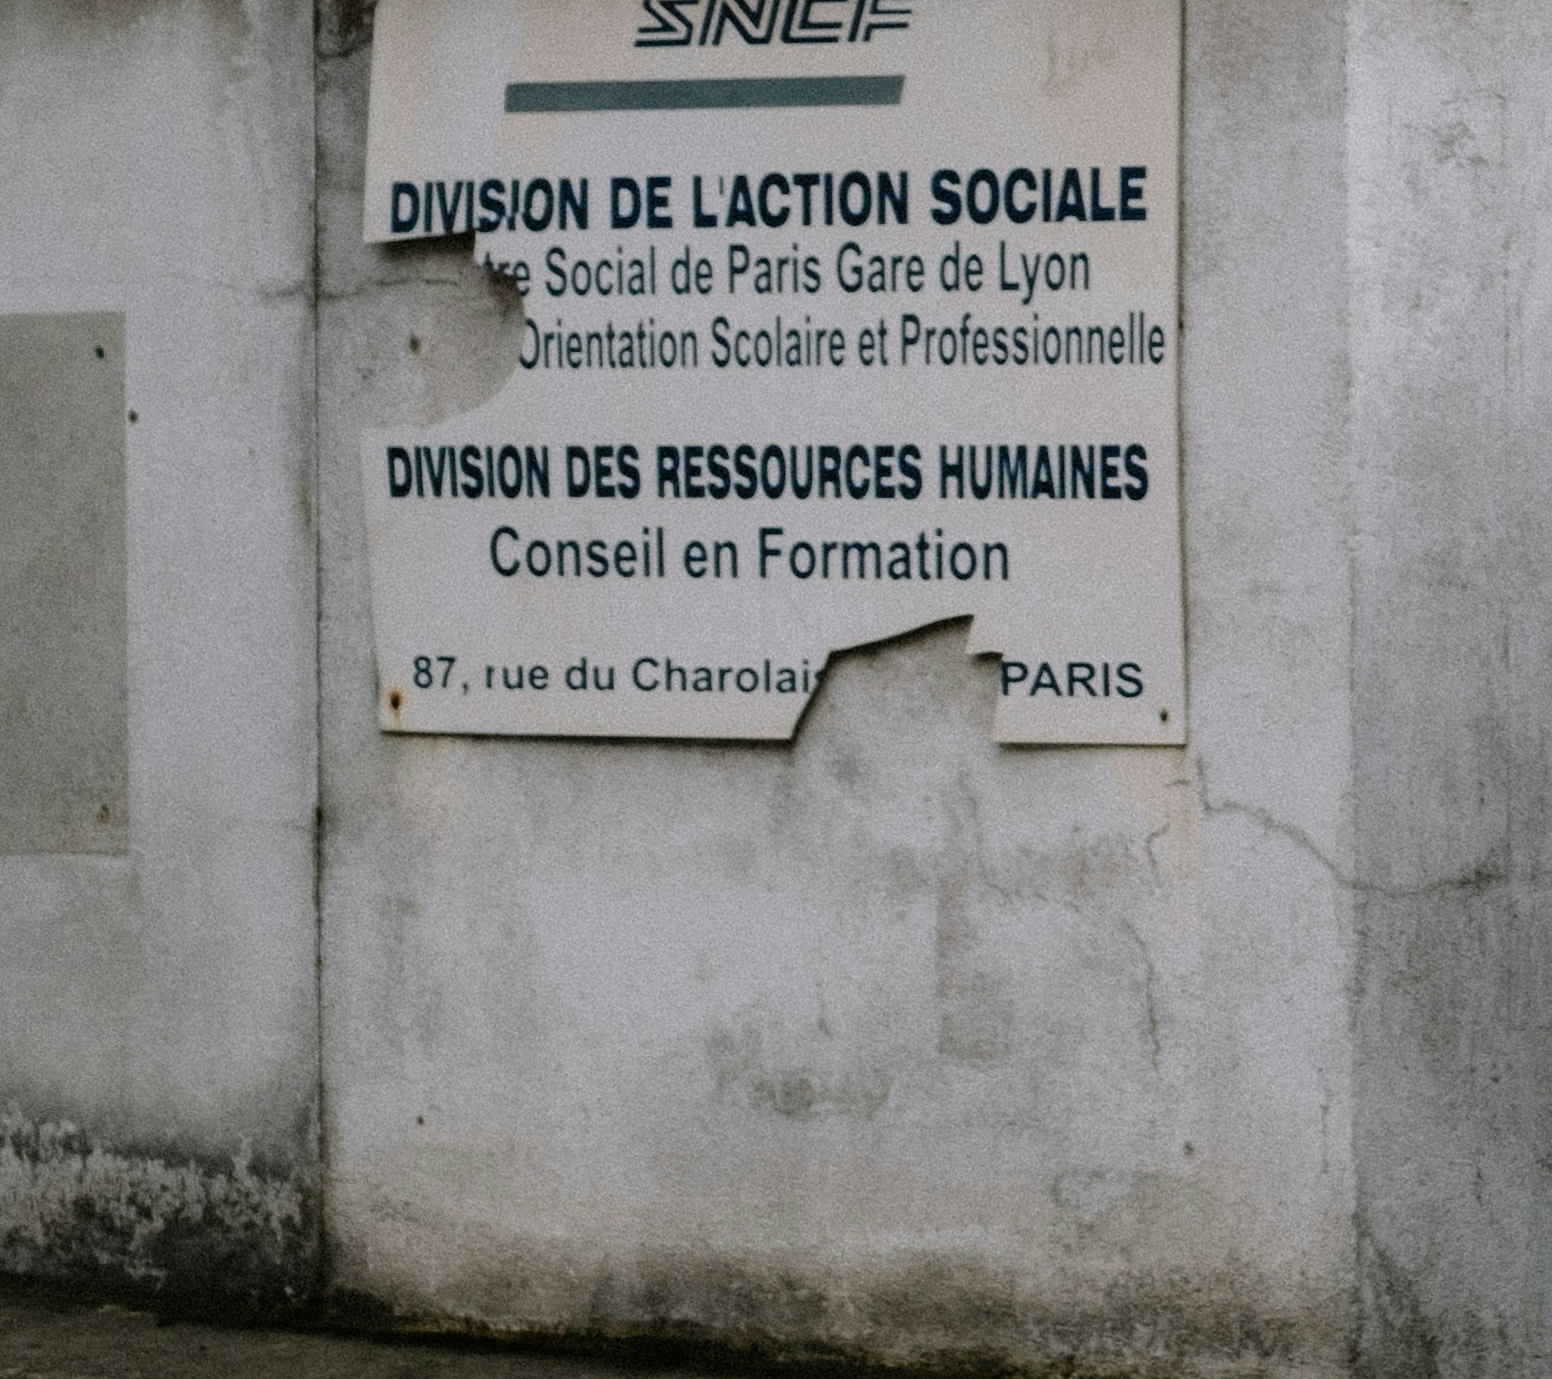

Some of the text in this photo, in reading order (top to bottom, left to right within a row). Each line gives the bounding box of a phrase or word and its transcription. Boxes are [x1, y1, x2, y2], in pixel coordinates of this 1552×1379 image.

[389, 166, 1147, 234] DIVISION DE L'ACTION SOCIALE
[543, 244, 656, 298] Social
[670, 245, 714, 296] de
[727, 243, 822, 295] Paris
[835, 240, 926, 294] Gare
[939, 241, 984, 293] de
[998, 240, 1090, 307] Lyon
[711, 315, 846, 369] Scolaire
[857, 319, 889, 368] et
[900, 312, 1166, 367] Professionnelle
[386, 443, 1149, 502] DIVISION DES RESSOURCES HUMAINES
[489, 525, 1009, 582] Conseil en Formation
[412, 654, 1144, 698] 87, rue du Charolai PARIS
